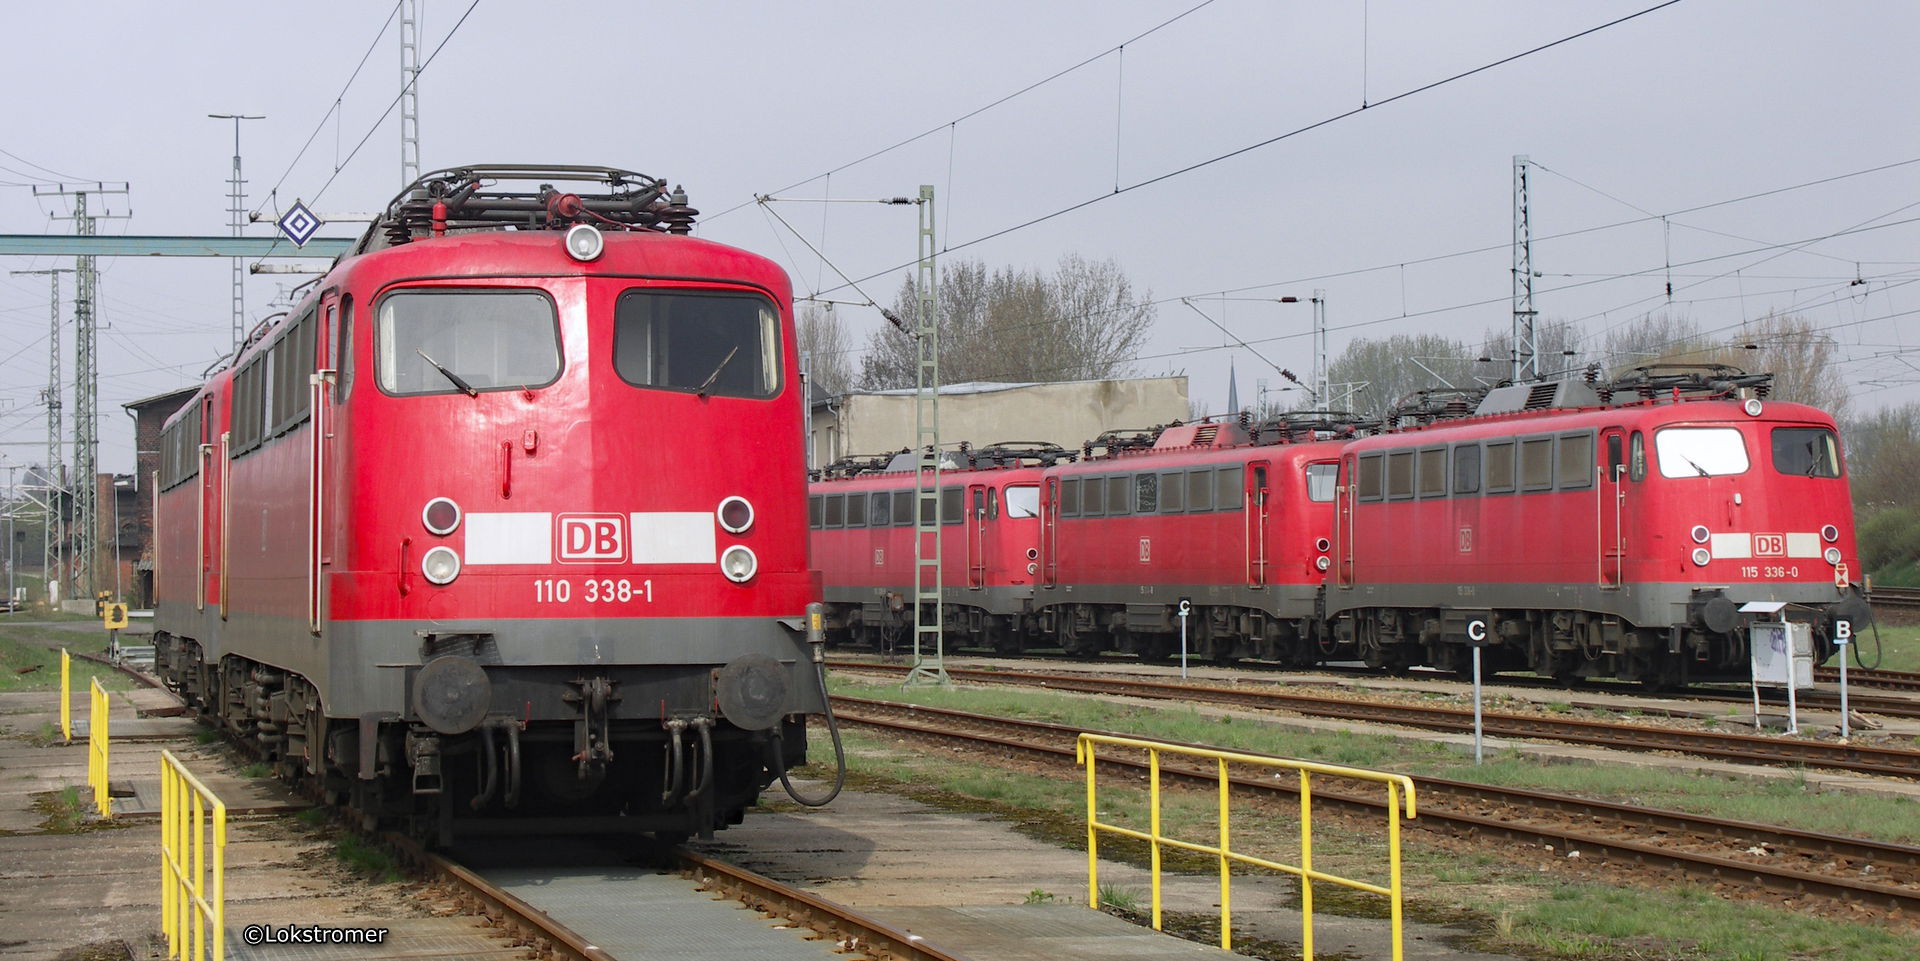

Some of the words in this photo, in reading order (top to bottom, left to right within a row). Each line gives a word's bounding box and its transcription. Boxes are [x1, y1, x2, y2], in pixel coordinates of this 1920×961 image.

[566, 521, 619, 555] DB
[1757, 537, 1781, 554] DB
[1741, 566, 1758, 578] 115
[1764, 566, 1799, 578] 336-0
[533, 579, 571, 603] 110
[584, 579, 653, 603] 338-1
[1179, 600, 1190, 612] C
[1467, 620, 1486, 641] C
[1836, 620, 1852, 638] B
